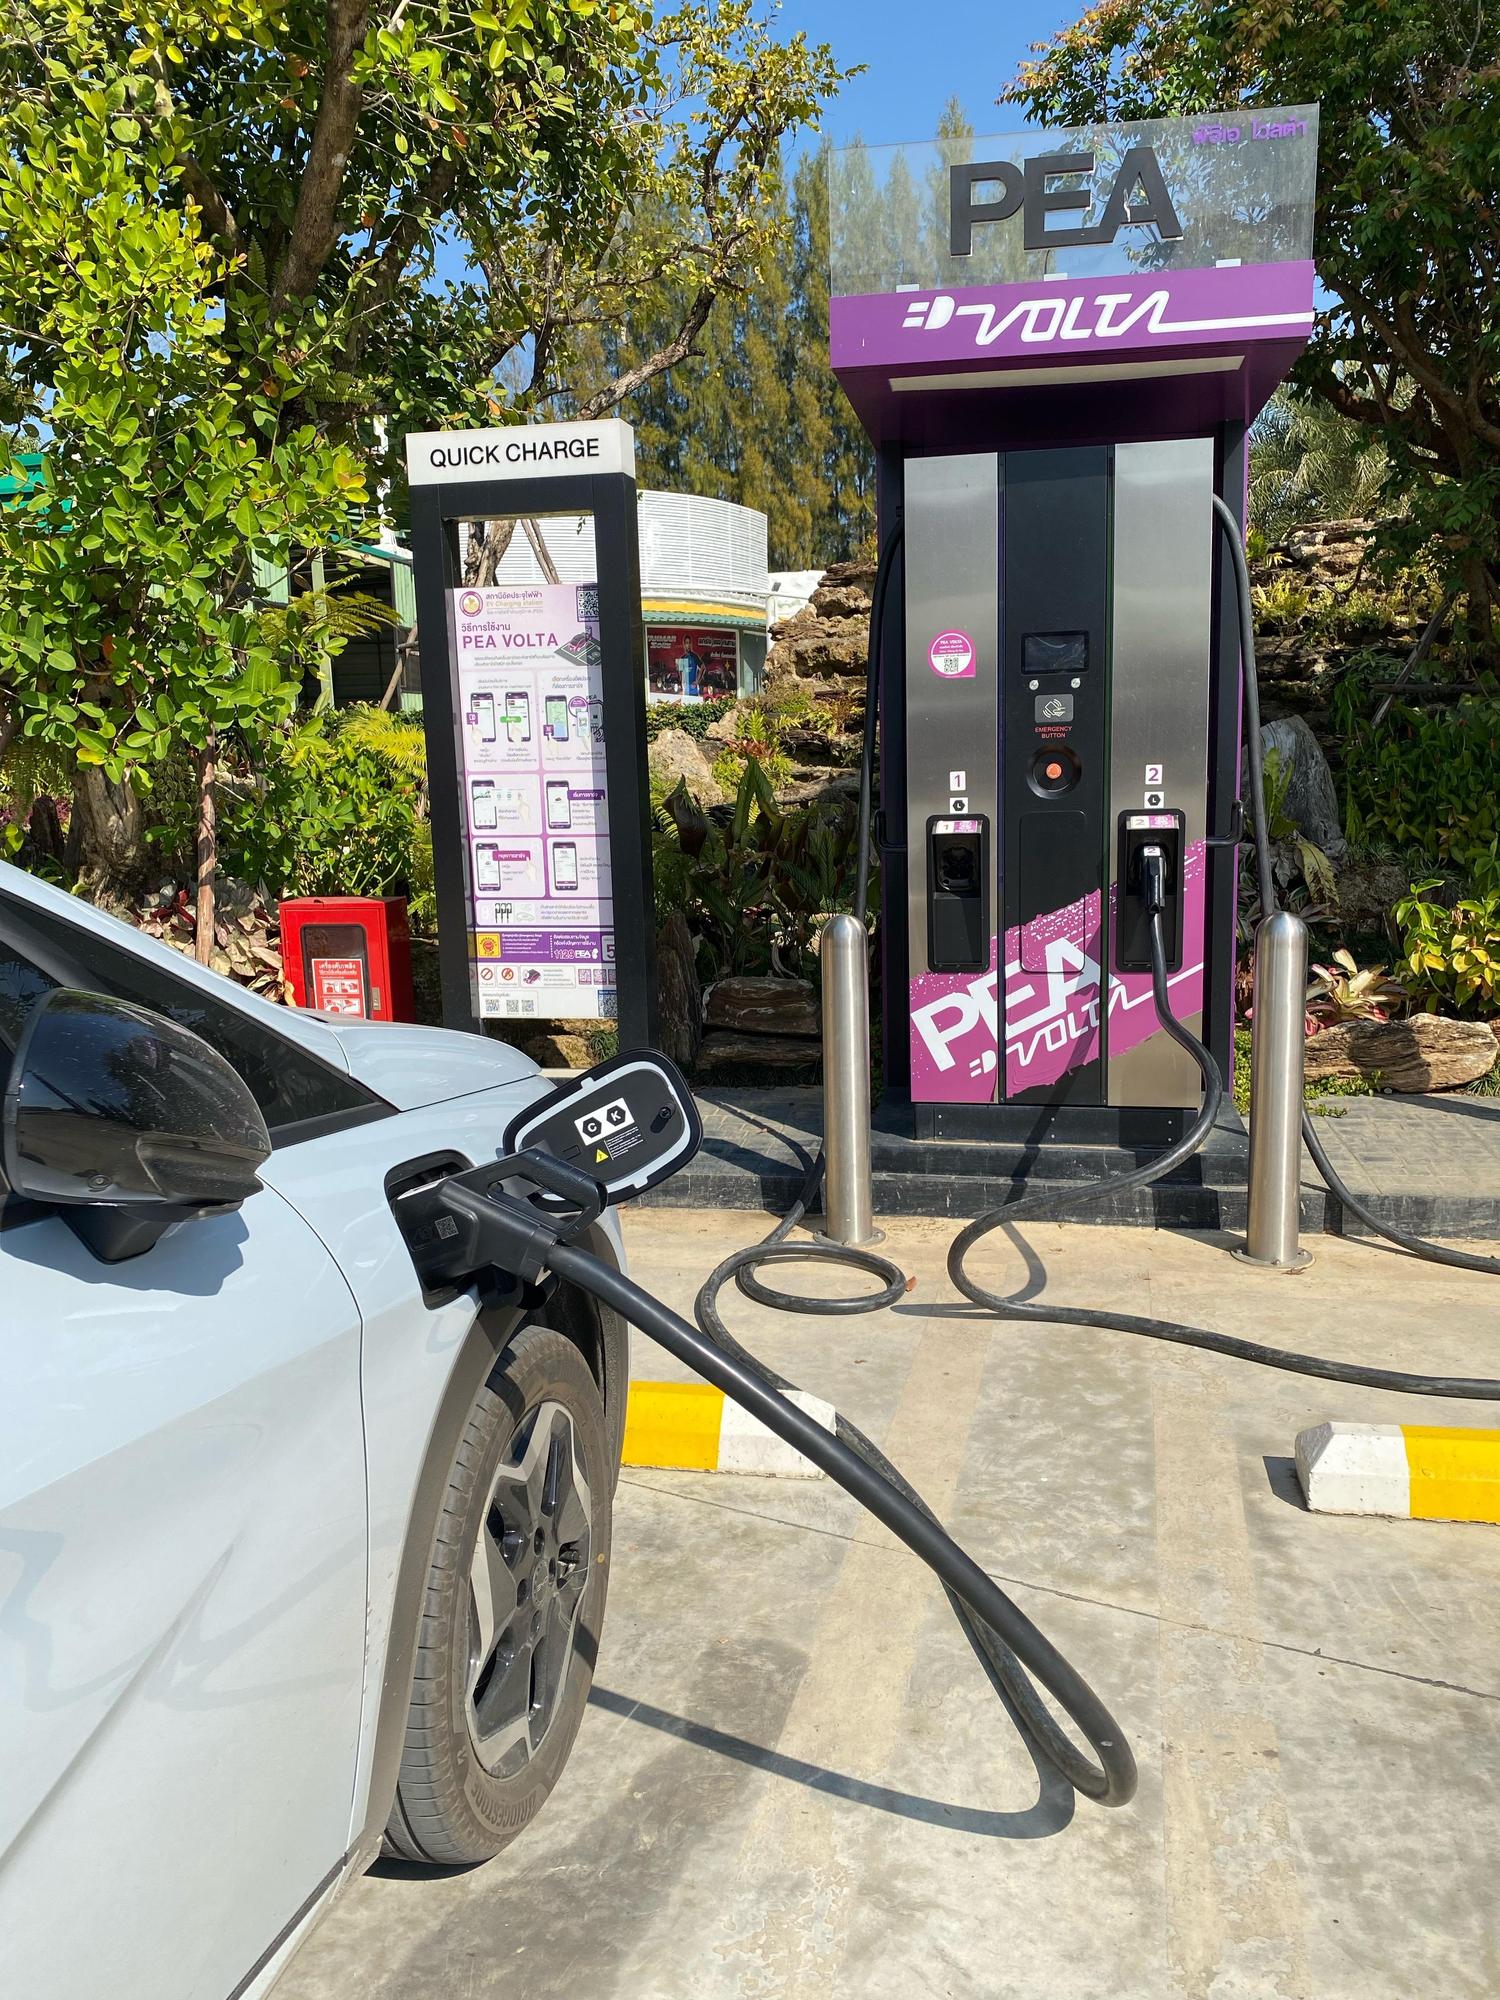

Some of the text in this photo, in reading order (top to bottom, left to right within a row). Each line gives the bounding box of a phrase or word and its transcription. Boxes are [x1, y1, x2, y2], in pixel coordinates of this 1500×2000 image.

[950, 147, 1184, 257] PEA
[956, 290, 1313, 345] VOLTA
[430, 438, 600, 468] QUICK CHARGE
[461, 621, 511, 632] วิธีการใช้งาน
[463, 633, 559, 648] PEA VOLTA
[954, 774, 961, 788] 1
[1148, 768, 1159, 781] 2
[910, 937, 1122, 1071] PEA
[587, 1110, 622, 1133] C K
